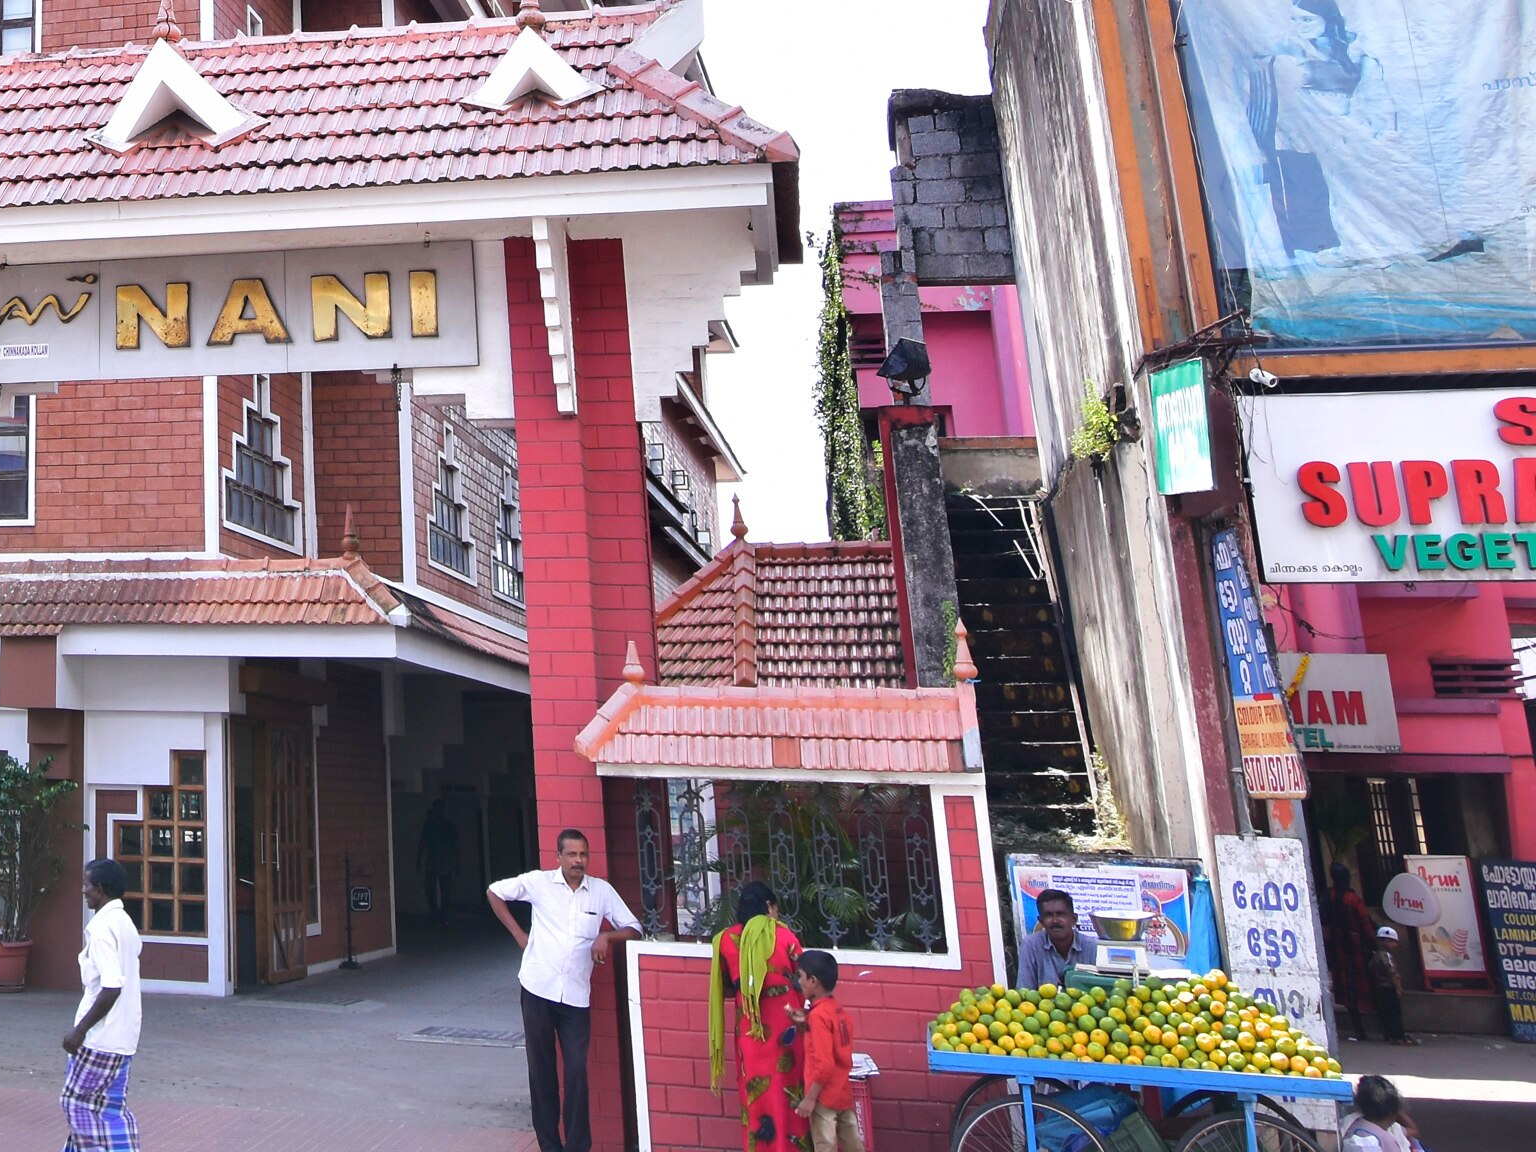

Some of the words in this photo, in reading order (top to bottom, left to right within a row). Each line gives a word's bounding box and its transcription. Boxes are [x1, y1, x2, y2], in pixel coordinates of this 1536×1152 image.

[114, 269, 439, 350] NANI
[1243, 757, 1266, 792] STD
[1264, 756, 1286, 792] ISD
[1504, 913, 1536, 927] COLOU
[1498, 943, 1524, 957] DTP
